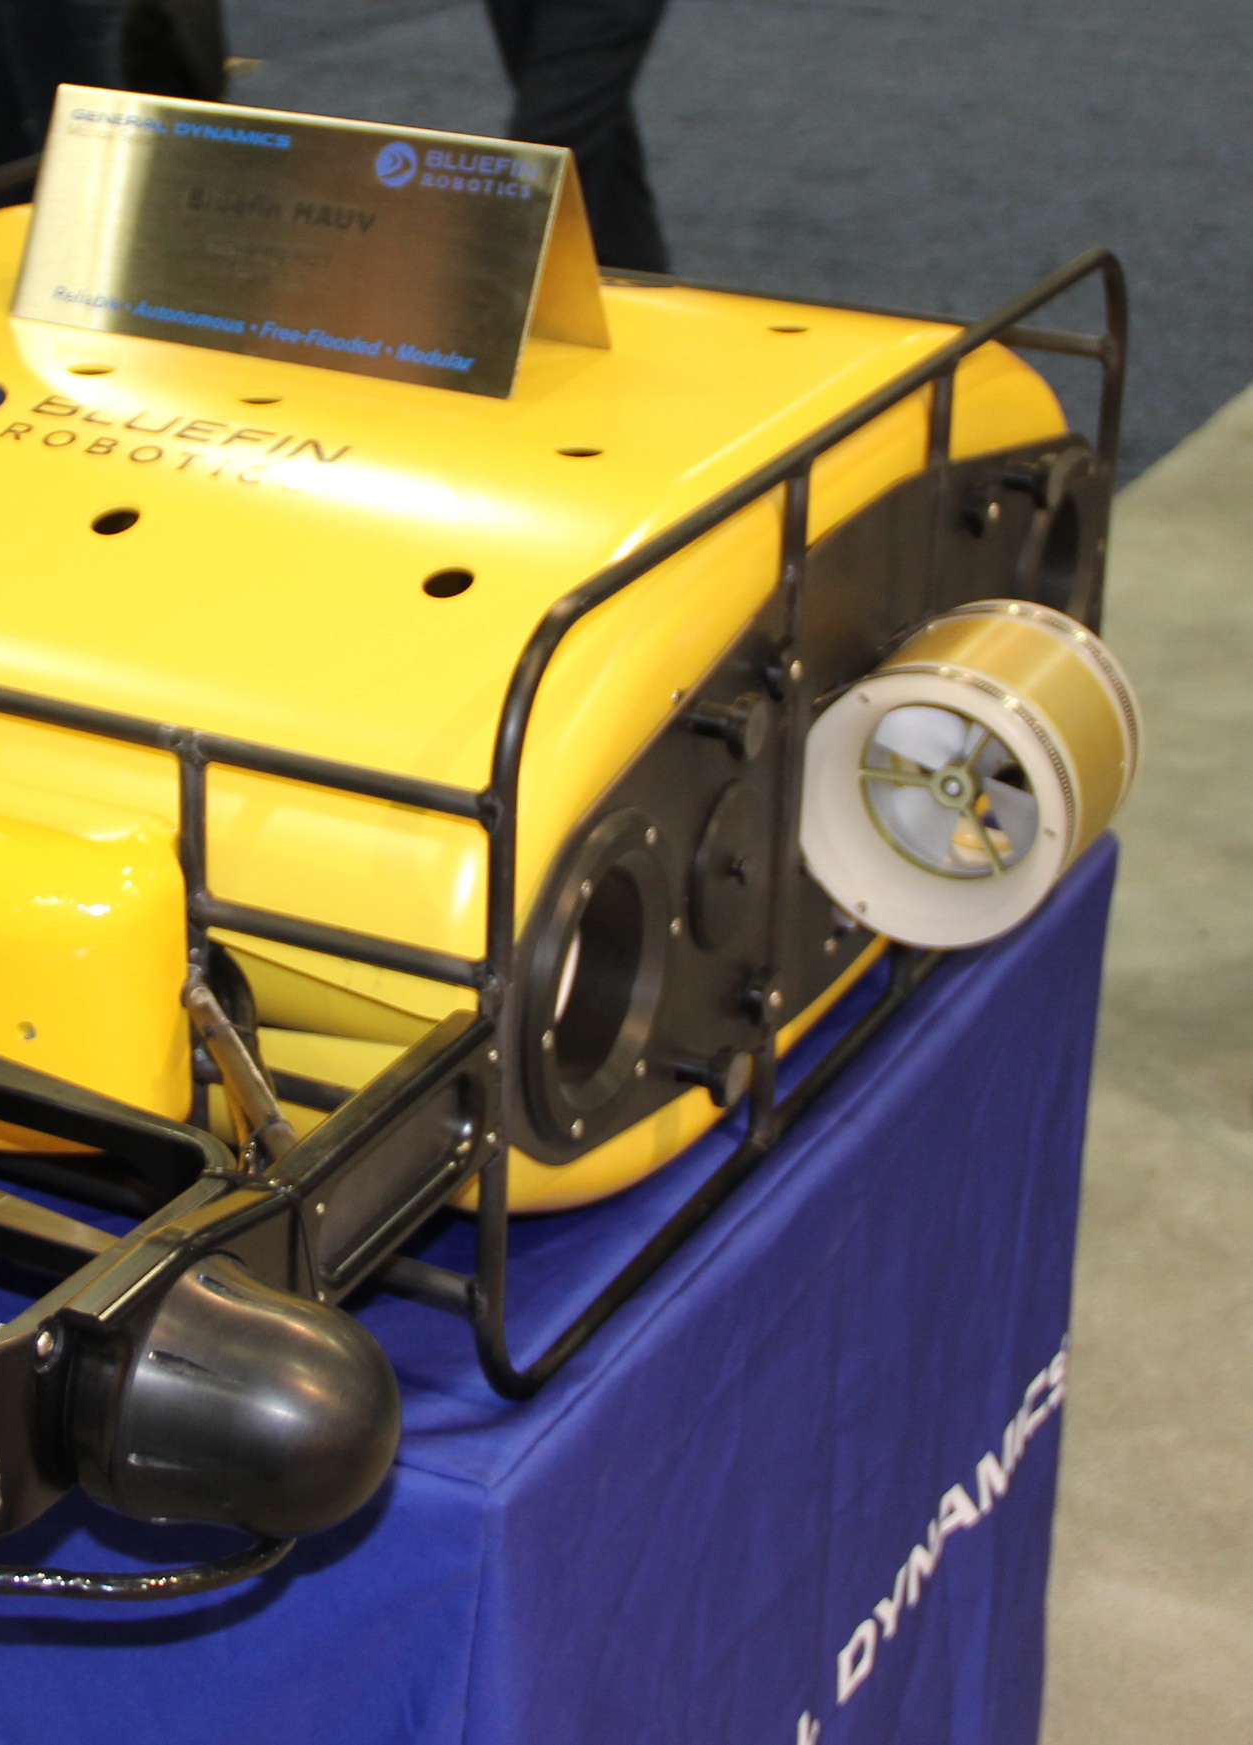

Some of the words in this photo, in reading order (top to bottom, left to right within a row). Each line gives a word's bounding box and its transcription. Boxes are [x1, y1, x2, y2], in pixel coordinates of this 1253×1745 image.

[71, 107, 168, 134] GENERAL
[173, 122, 293, 150] DYNAMICS
[425, 149, 540, 179] BLUEFIN
[420, 173, 532, 199] ROBOTICS
[133, 299, 247, 336] Autonomous
[259, 319, 383, 357] Free-Flooded
[395, 343, 475, 374] Modular
[30, 394, 353, 464] BLUEFIN
